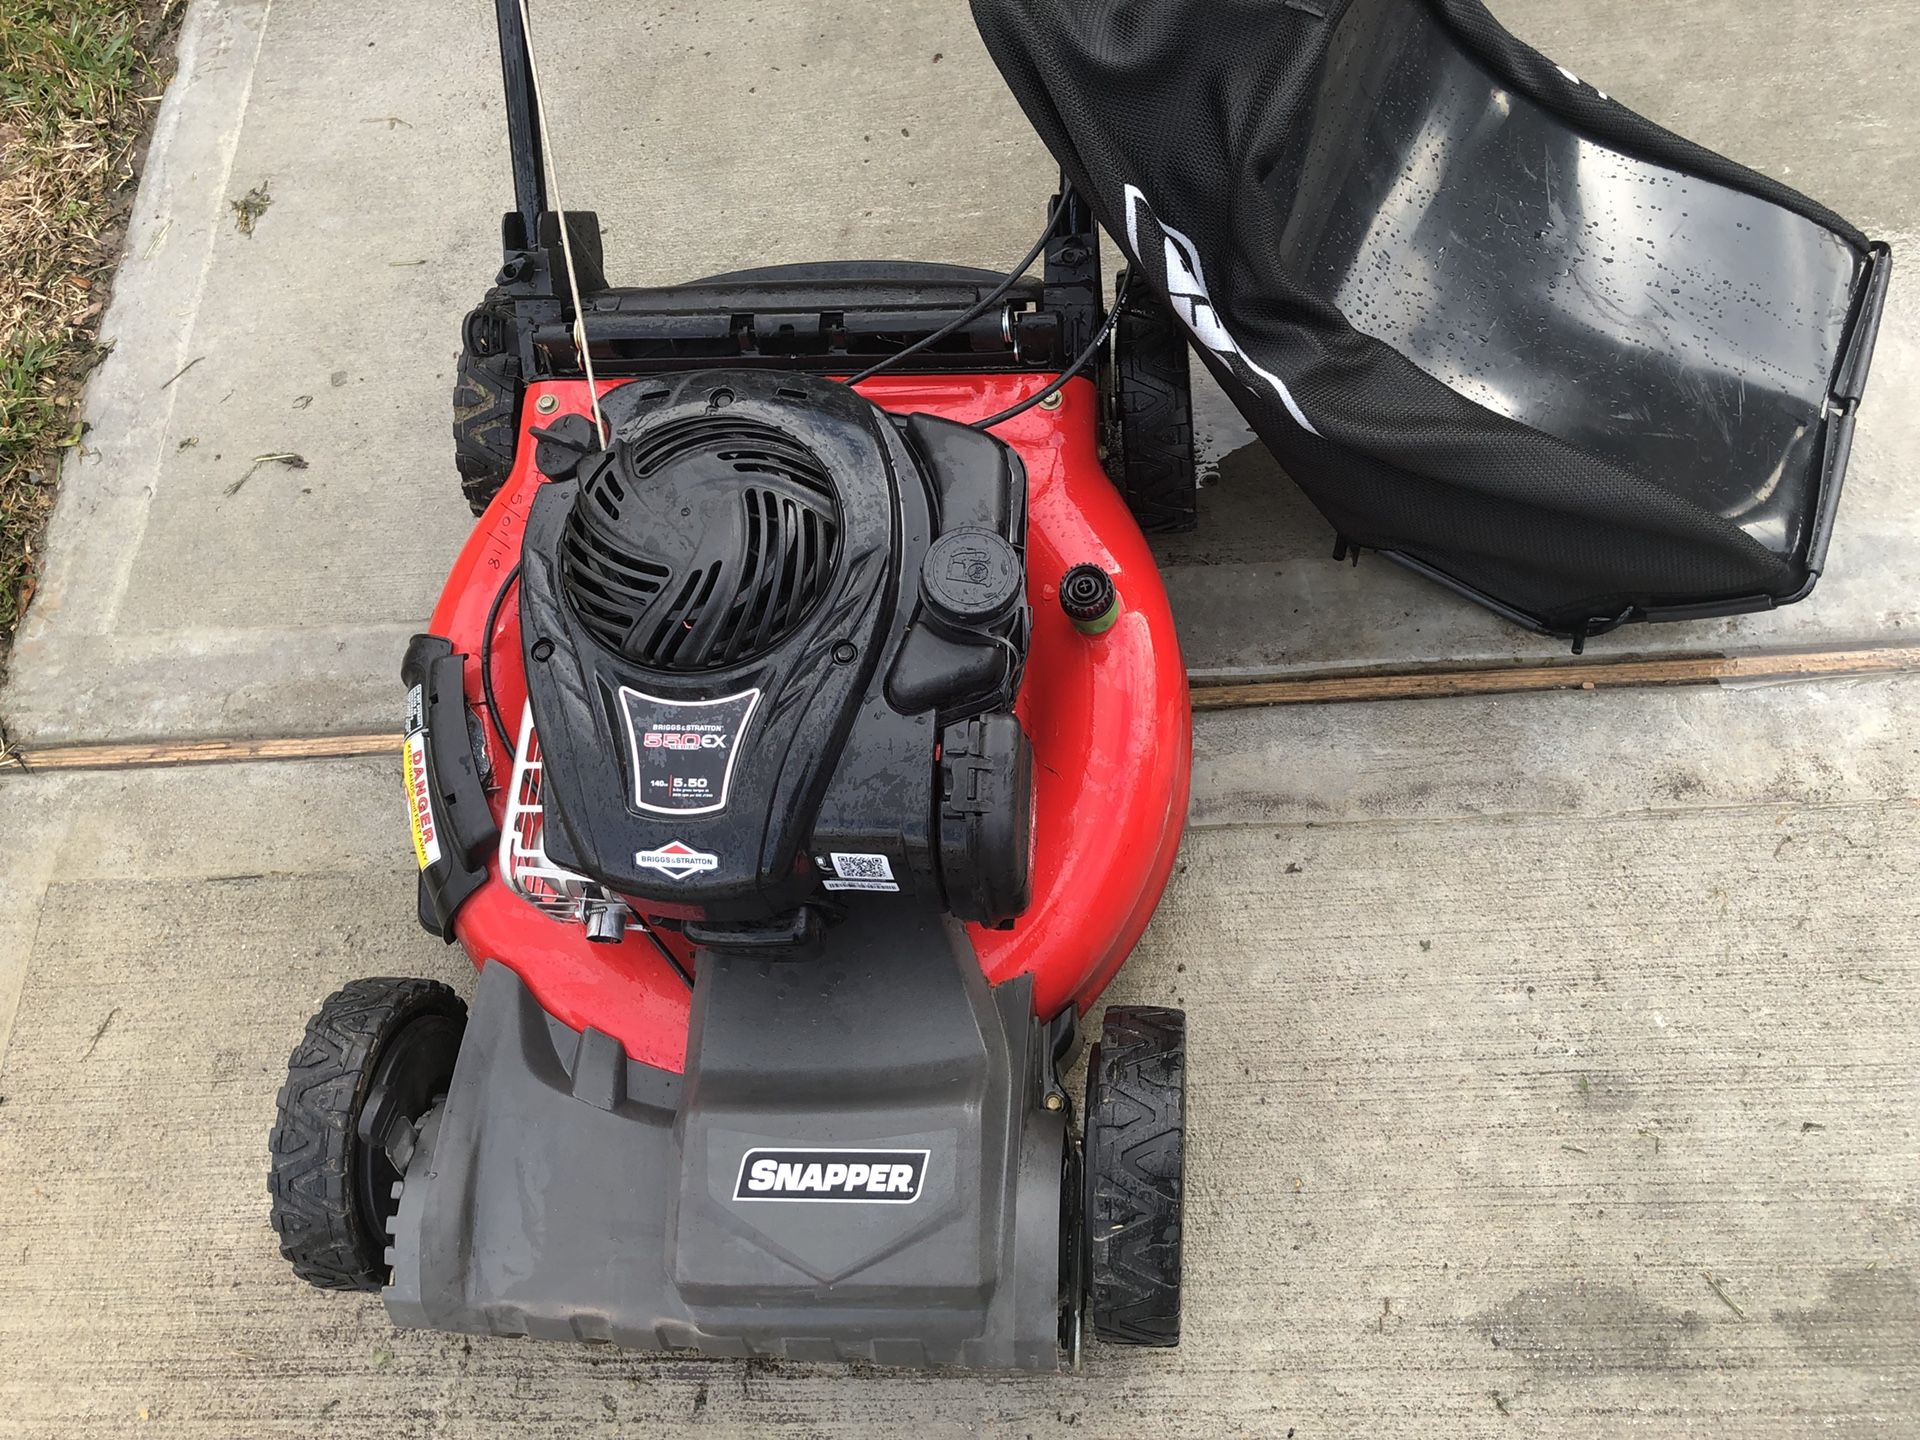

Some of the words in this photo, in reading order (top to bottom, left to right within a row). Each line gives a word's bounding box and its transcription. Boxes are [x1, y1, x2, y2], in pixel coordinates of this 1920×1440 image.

[487, 493, 522, 570] 5/01/18
[412, 749, 434, 844] DANGER
[673, 777, 708, 788] 5.50
[748, 1159, 912, 1193] SNAPPER
